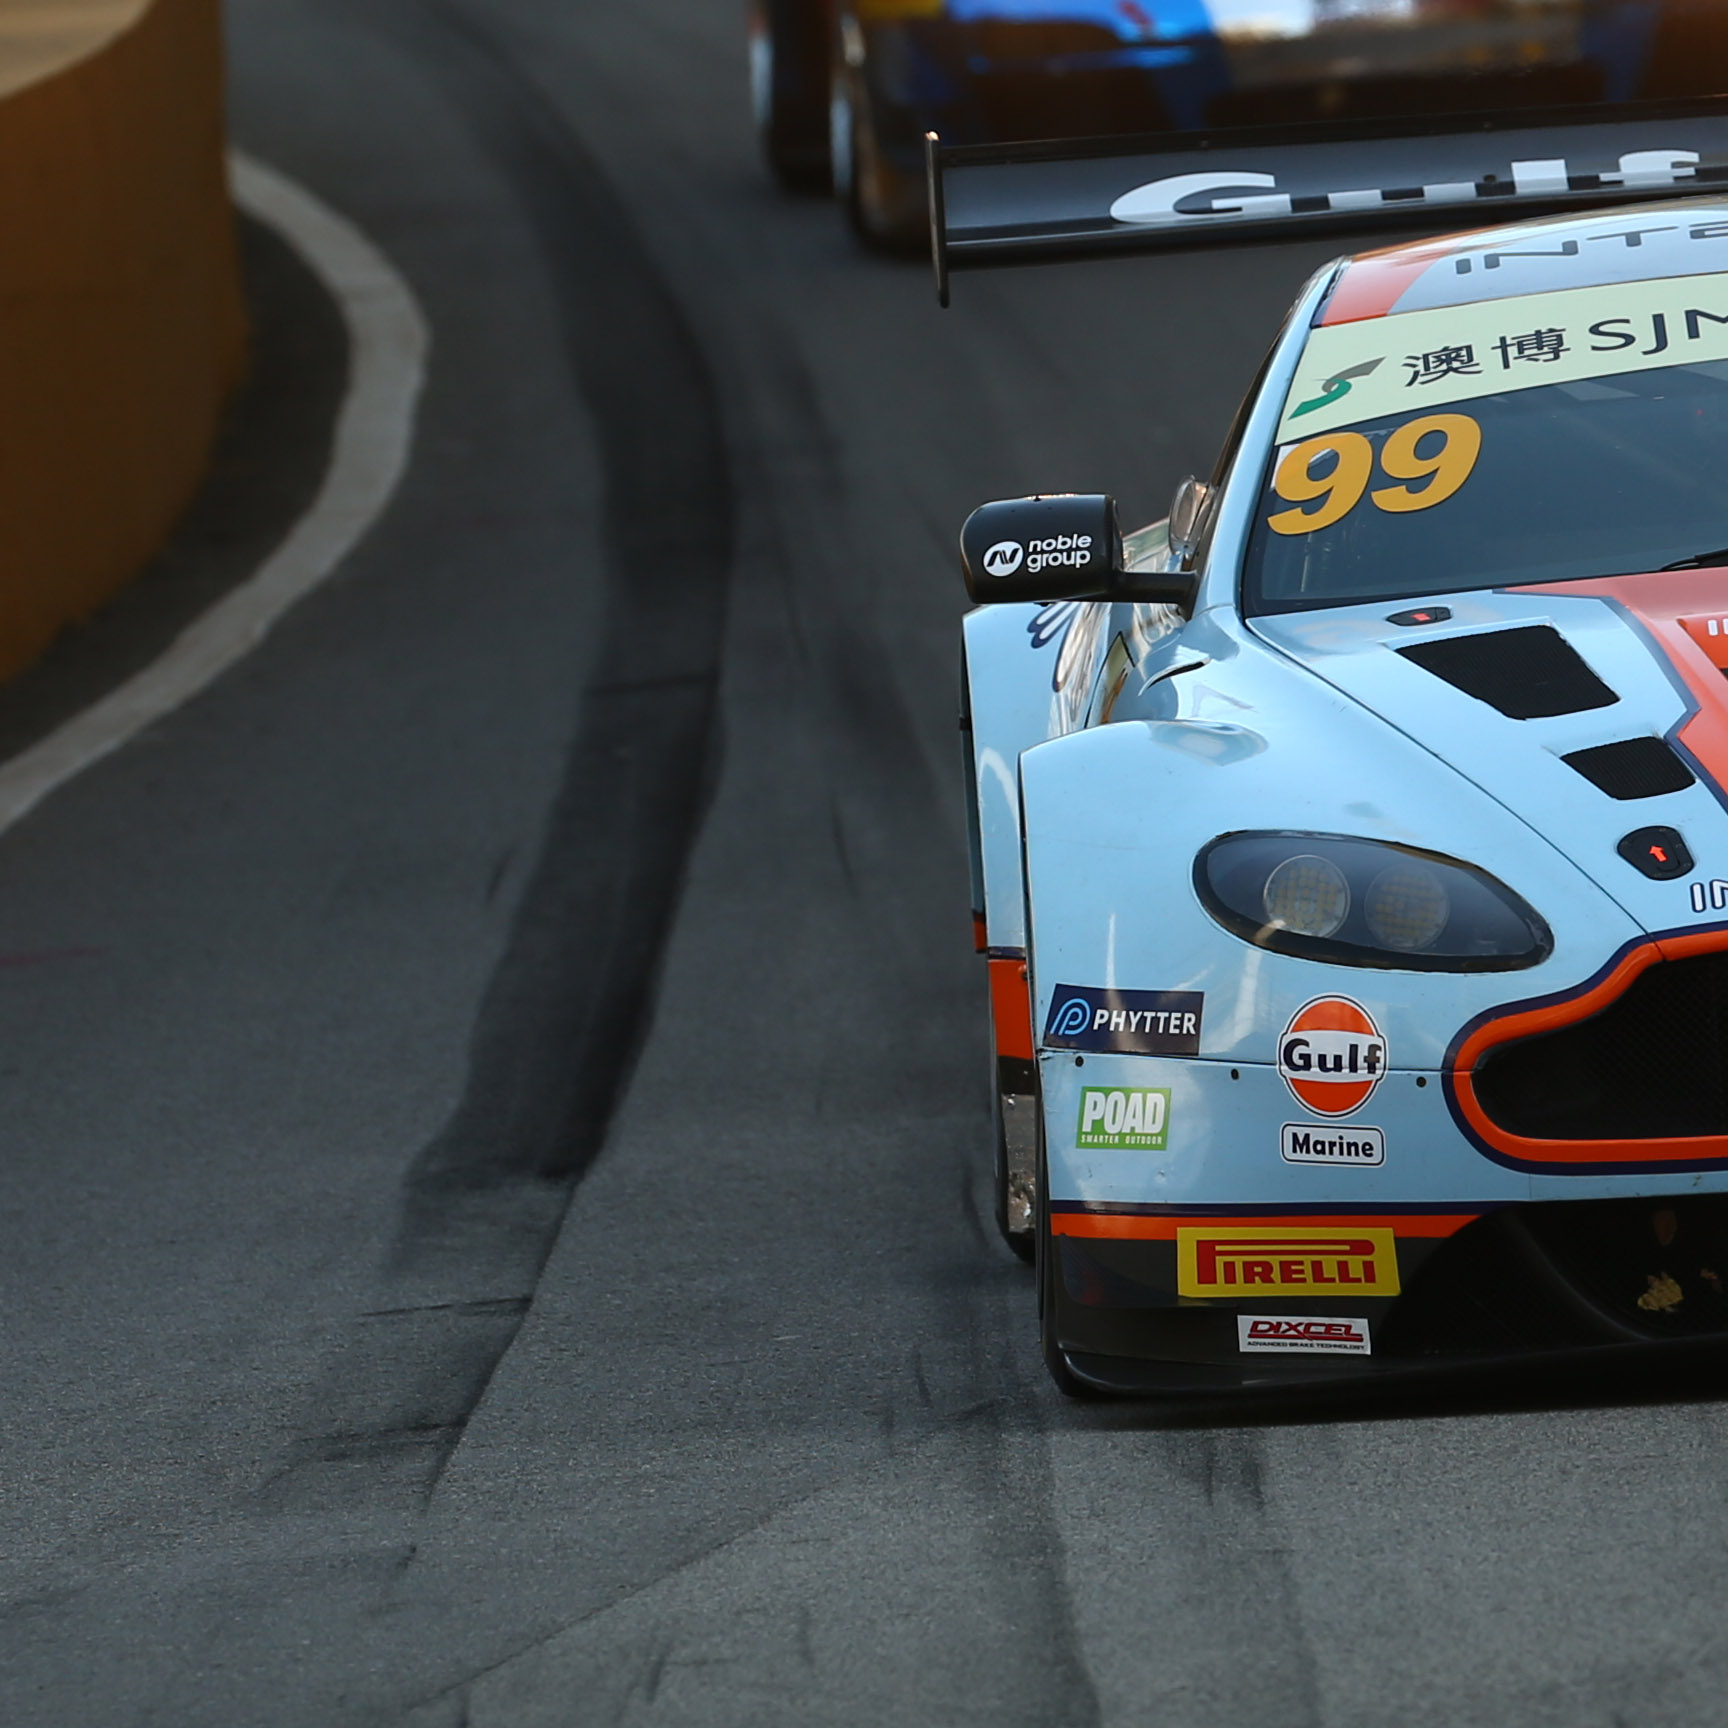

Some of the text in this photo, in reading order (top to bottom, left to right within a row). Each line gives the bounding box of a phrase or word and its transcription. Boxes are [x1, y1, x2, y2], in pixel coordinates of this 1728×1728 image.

[1267, 413, 1482, 535] 99
[1028, 533, 1092, 553] noble
[1027, 549, 1091, 572] group
[1092, 1008, 1197, 1035] PHYTTER
[1283, 1038, 1382, 1075] Gulf
[1082, 1091, 1165, 1134] POAD
[1081, 1134, 1163, 1145] SMARTER OUTDOOR
[1291, 1132, 1375, 1159] Marine
[1196, 1239, 1377, 1285] PIRELLI
[1248, 1320, 1363, 1340] DIXCEL
